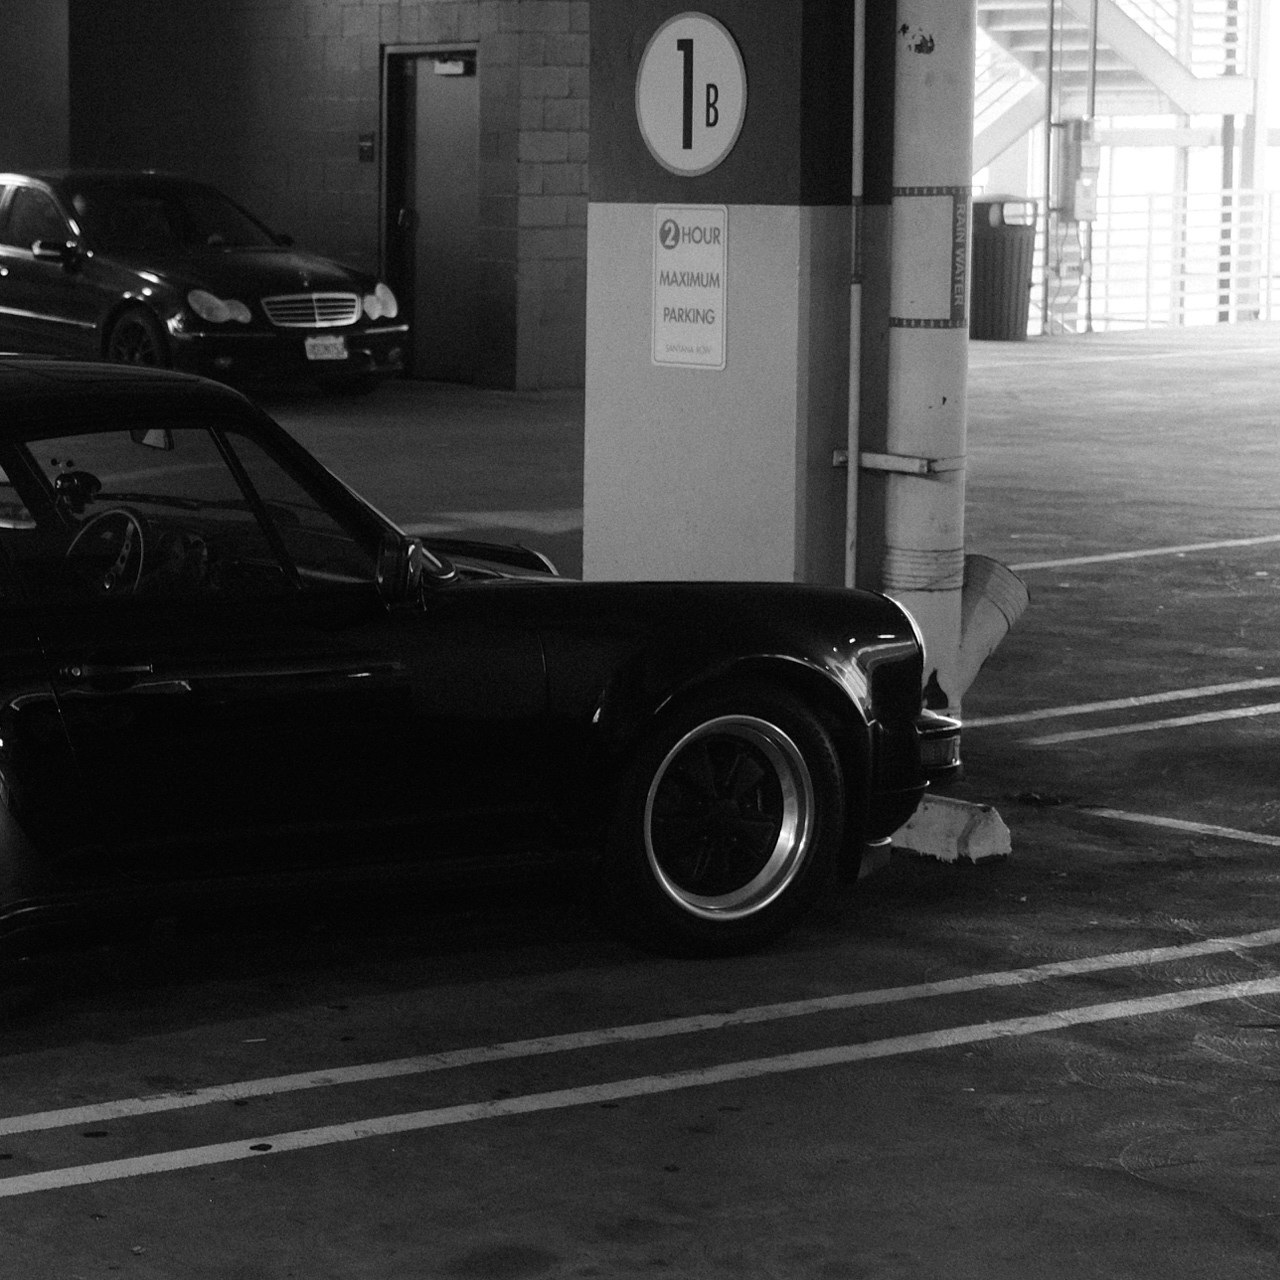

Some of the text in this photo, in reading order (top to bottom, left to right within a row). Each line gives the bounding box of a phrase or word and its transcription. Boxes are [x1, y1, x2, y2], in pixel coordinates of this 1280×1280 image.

[663, 220, 721, 248] 2 HOUR
[953, 203, 966, 306] RAIN WATER
[659, 271, 720, 288] MAXIMUM
[663, 307, 716, 325] PARKING
